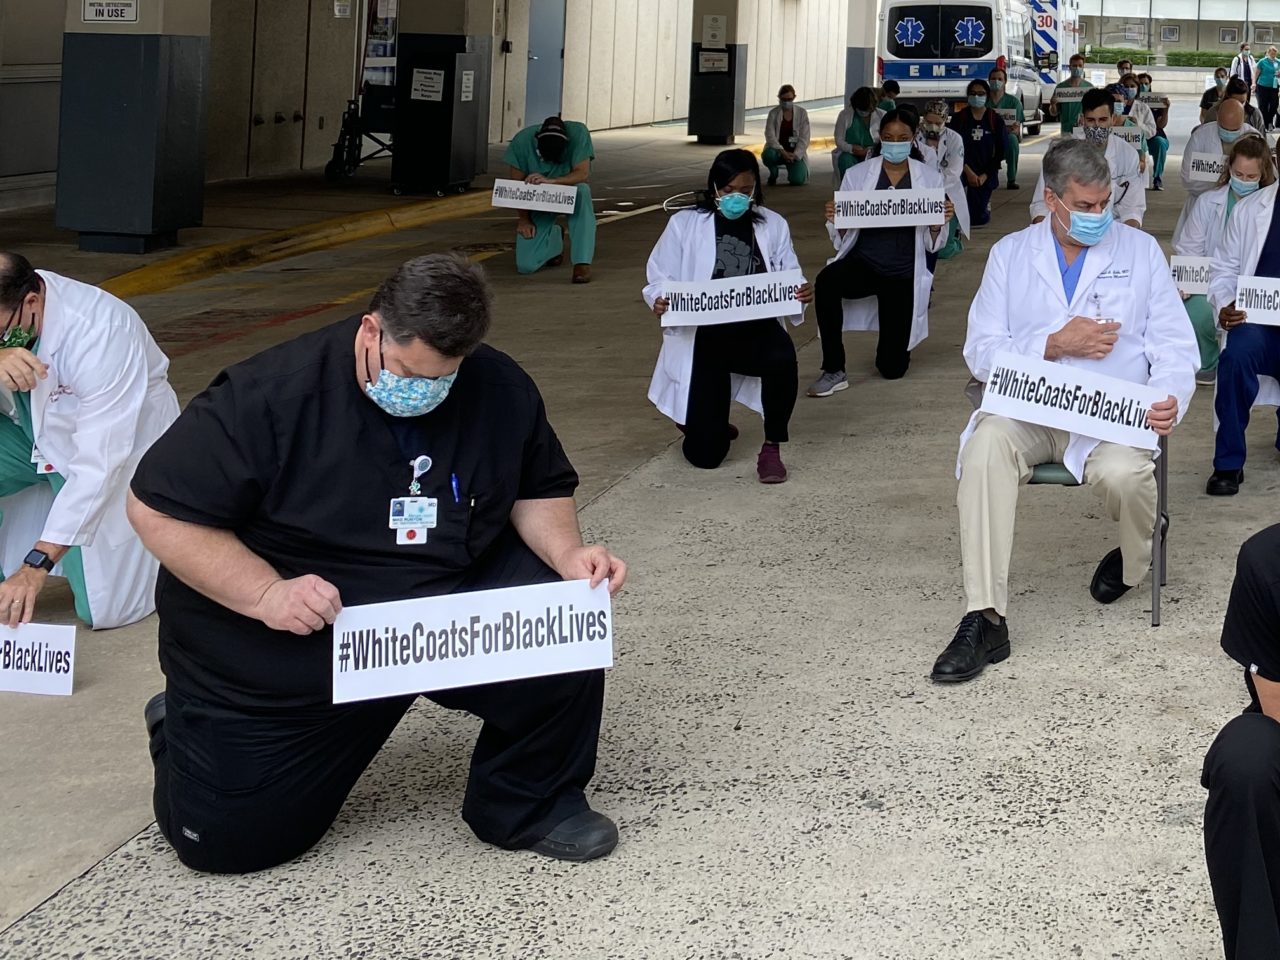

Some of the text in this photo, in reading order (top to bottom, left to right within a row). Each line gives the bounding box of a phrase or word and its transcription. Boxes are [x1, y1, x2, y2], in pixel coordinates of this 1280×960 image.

[95, 8, 126, 18] IN USE
[1037, 15, 1053, 28] 30
[495, 185, 575, 205] #WhiteCoatsForBlackLives
[836, 199, 944, 218] #WhiteCoatsForBlackLives
[665, 282, 800, 313] #WhiteCoatsForBlackLives
[339, 604, 608, 673] #WhiteCoatsForBlackLives
